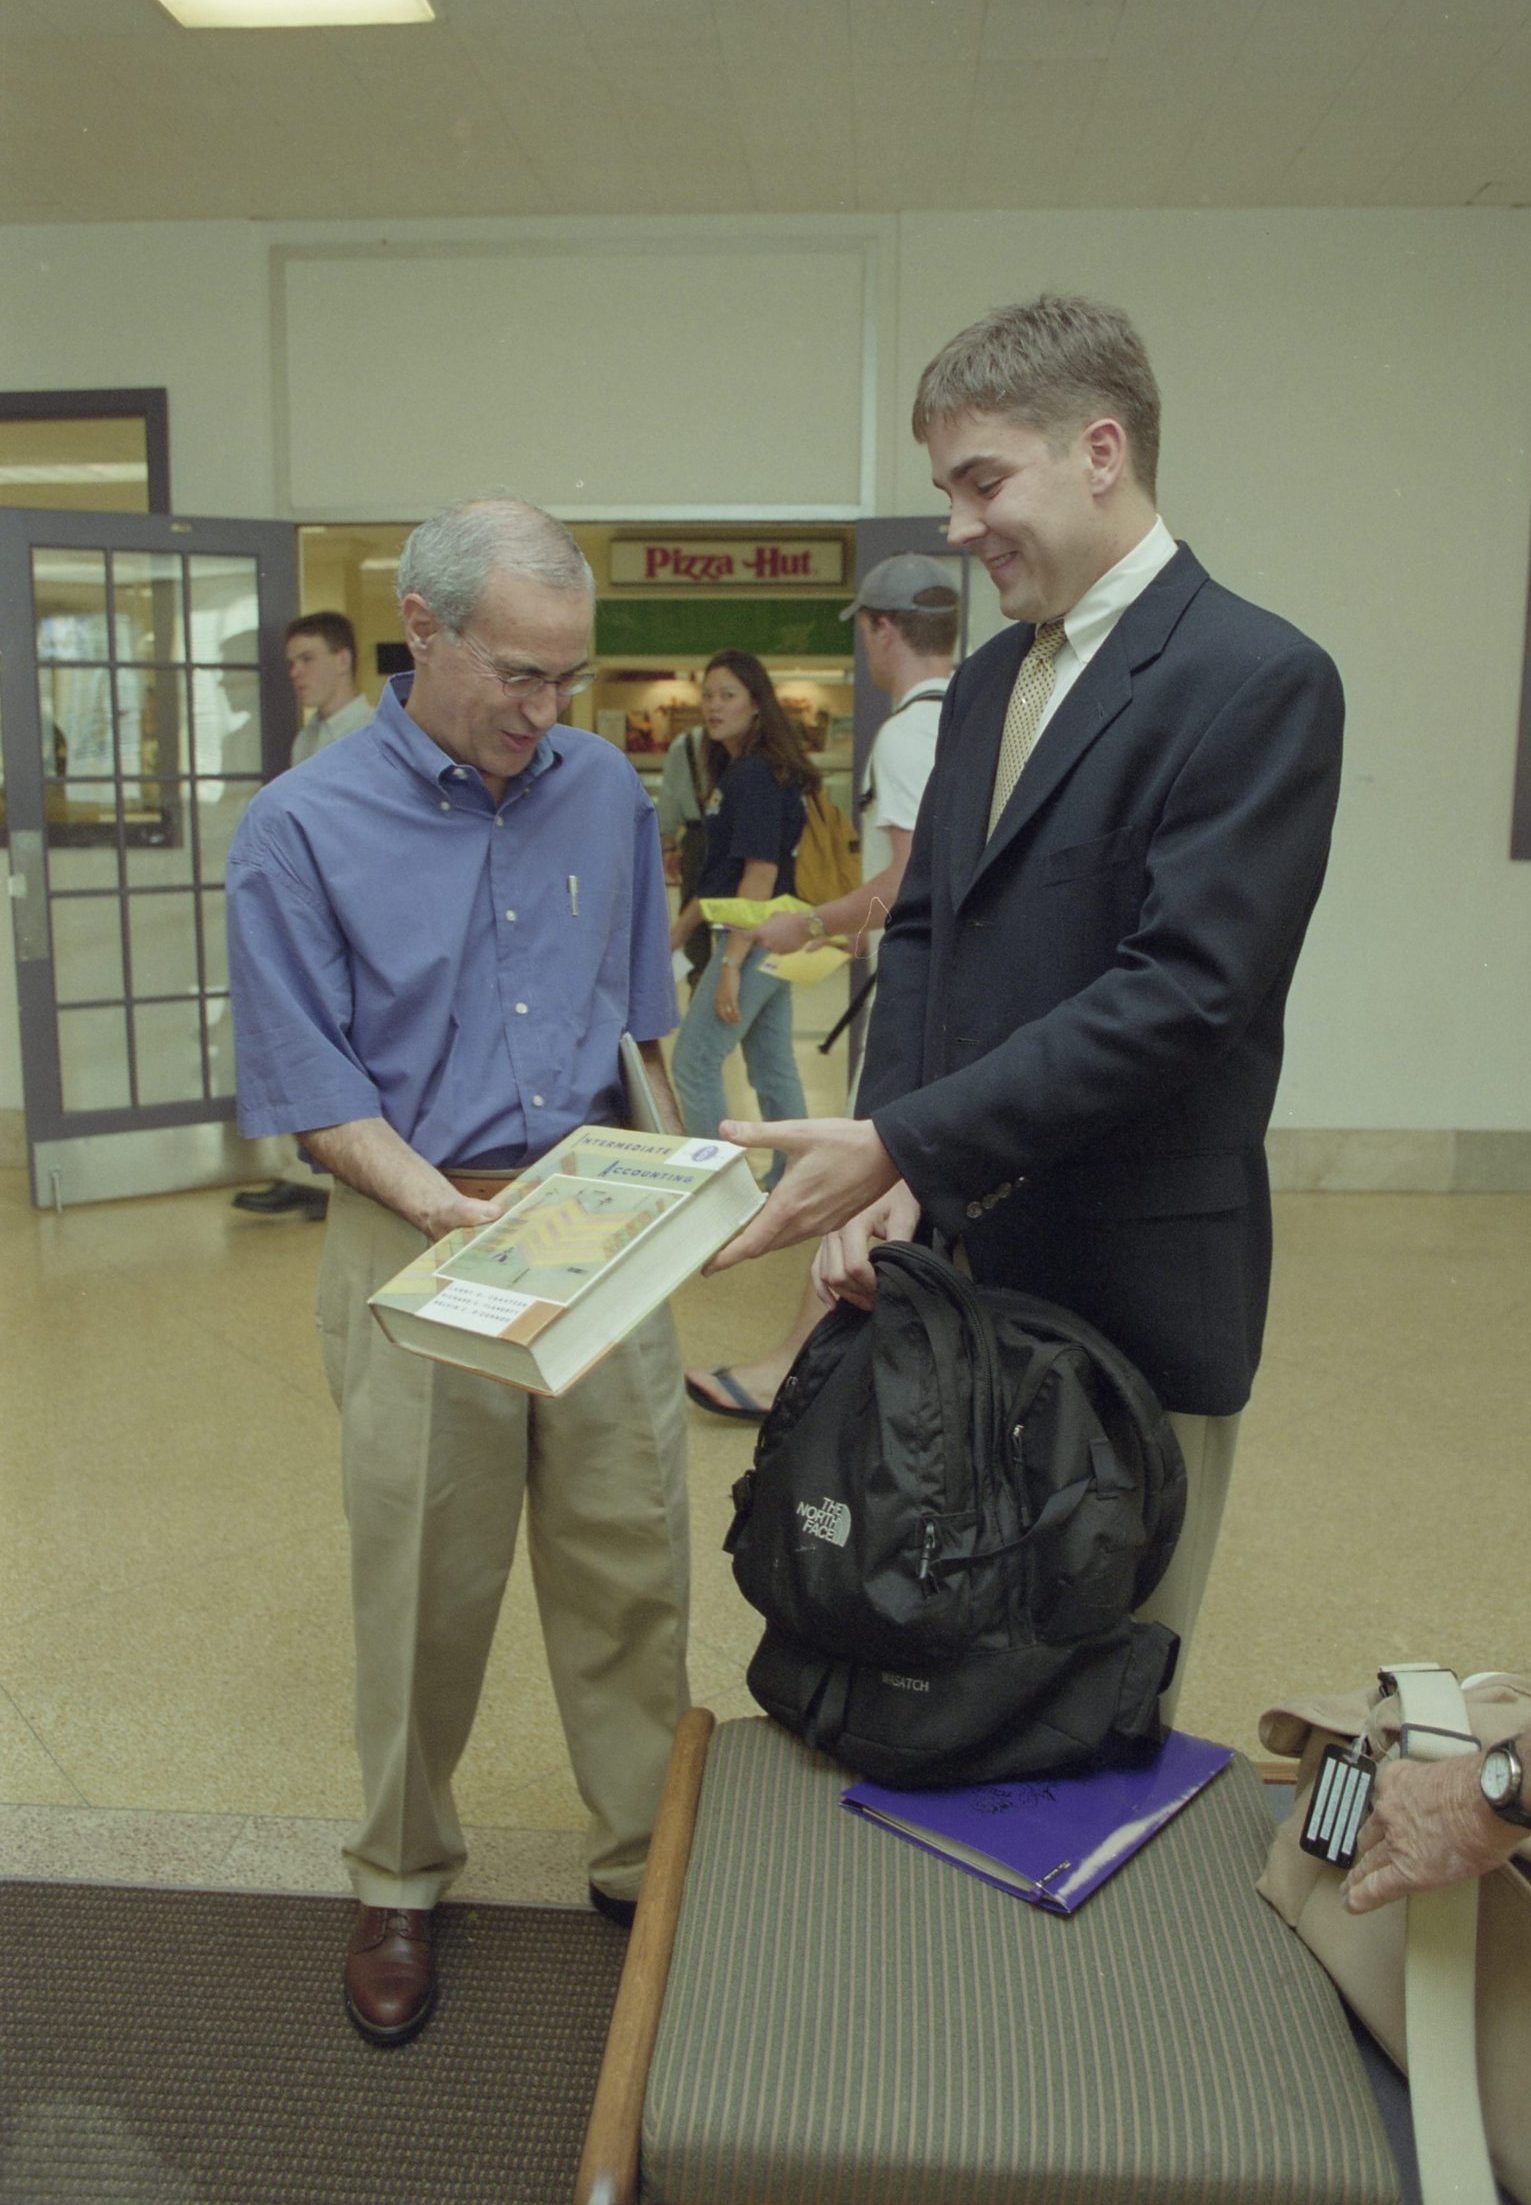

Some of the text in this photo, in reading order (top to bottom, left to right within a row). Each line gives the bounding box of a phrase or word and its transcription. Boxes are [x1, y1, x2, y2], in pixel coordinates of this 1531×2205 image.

[645, 545, 812, 581] Pizza Hut
[571, 1132, 671, 1155] INTERMEDIATE
[598, 1159, 695, 1184] ACCOUNTING
[796, 1501, 842, 1529] NORTH
[823, 1496, 843, 1516] THE
[802, 1518, 837, 1542] FACE
